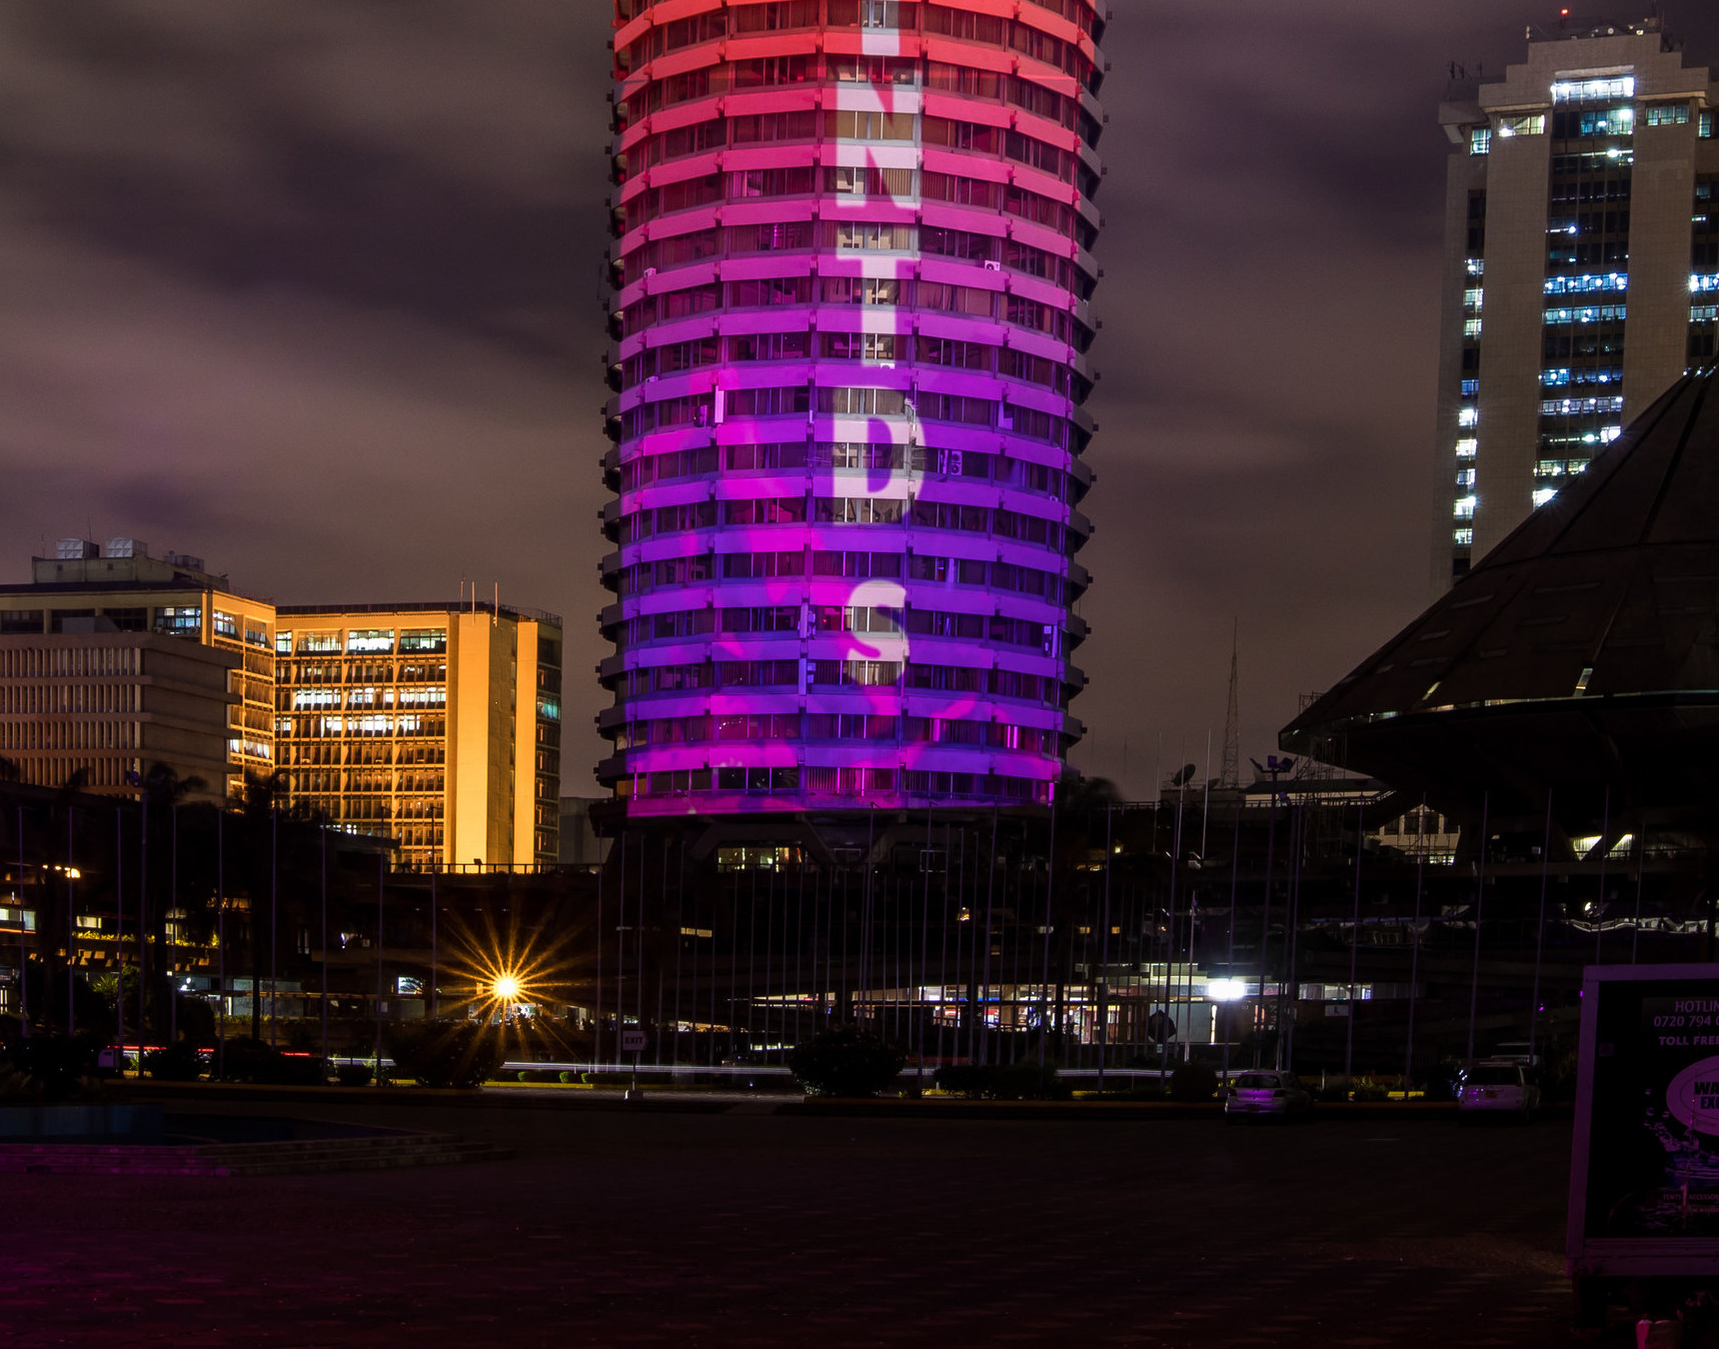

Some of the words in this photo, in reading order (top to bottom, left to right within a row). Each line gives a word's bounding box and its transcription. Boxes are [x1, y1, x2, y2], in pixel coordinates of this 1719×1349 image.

[1653, 1015, 1685, 1027] 0720
[1689, 1015, 1711, 1027] 794
[625, 1036, 644, 1044] EXIT
[1658, 1036, 1689, 1046] TOLL
